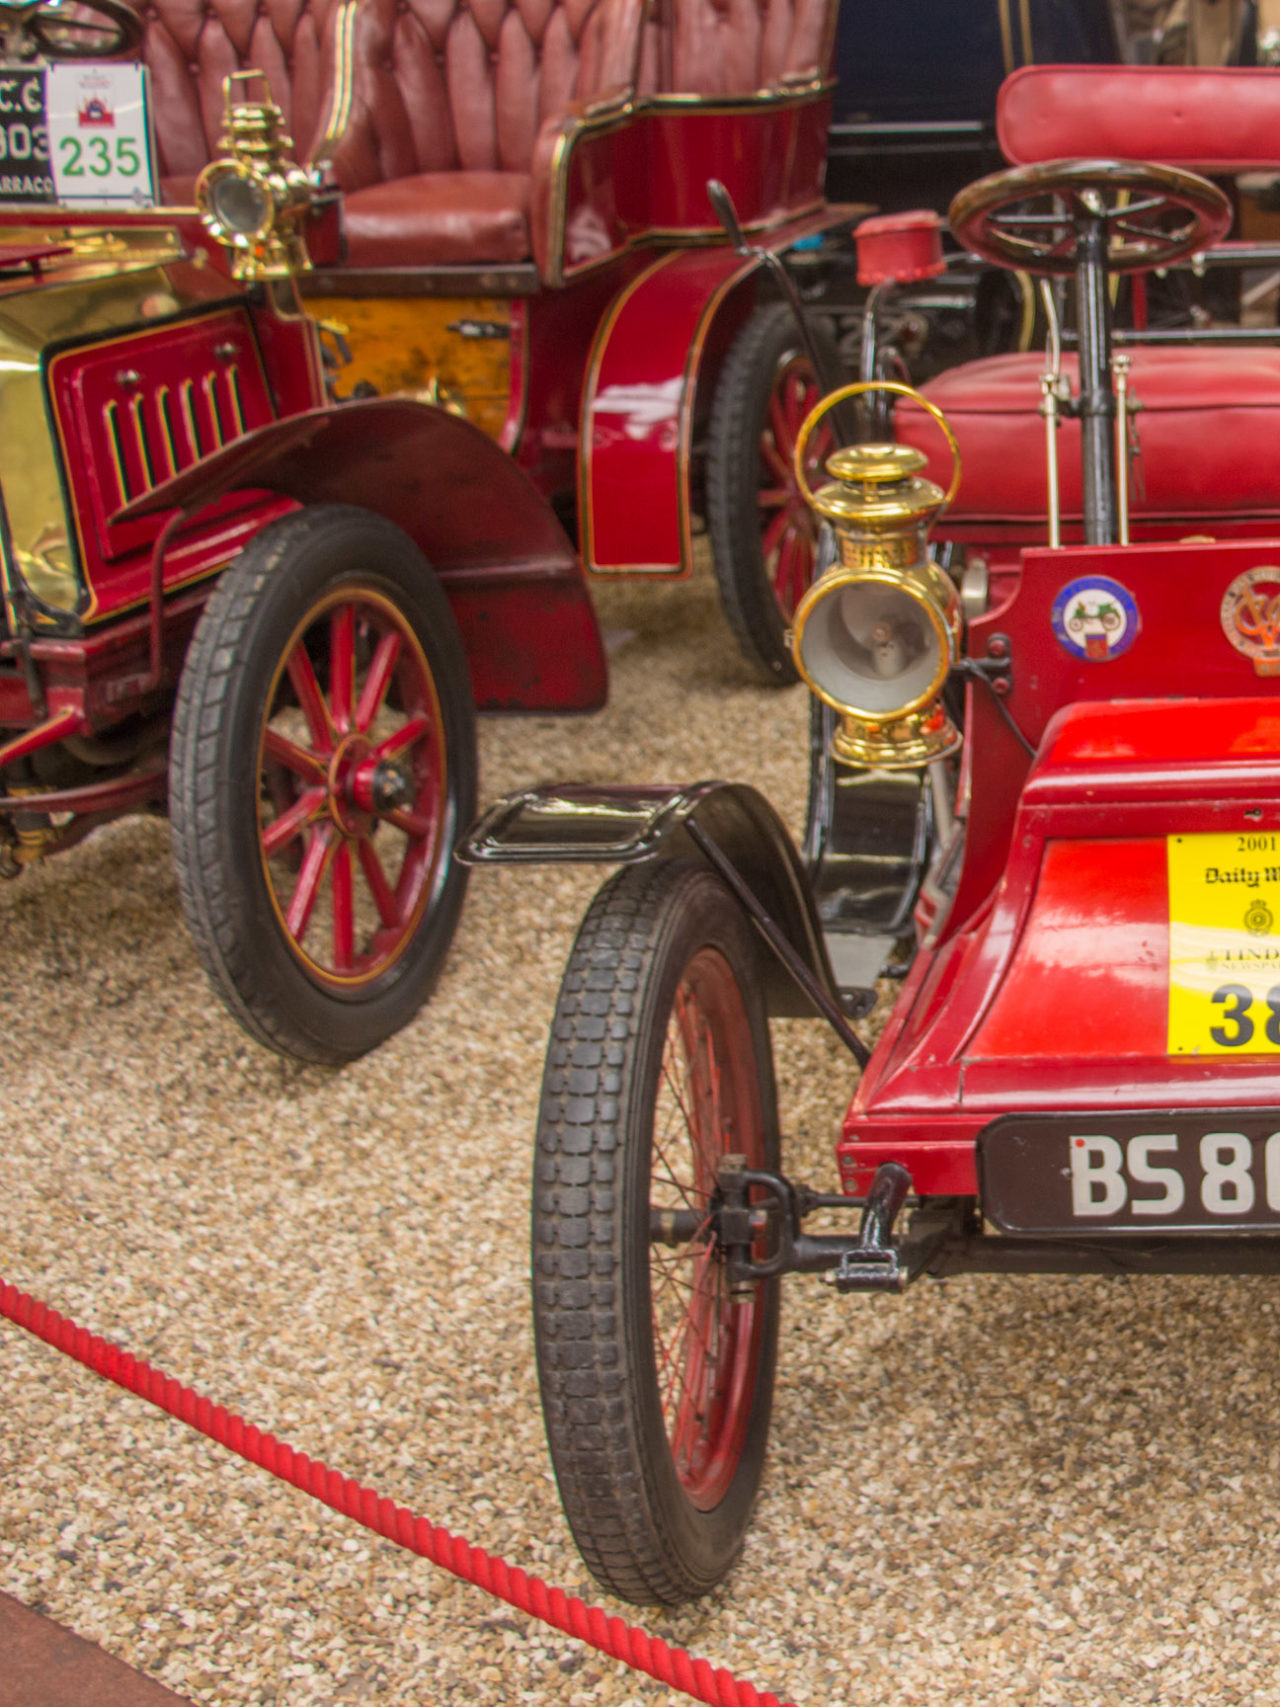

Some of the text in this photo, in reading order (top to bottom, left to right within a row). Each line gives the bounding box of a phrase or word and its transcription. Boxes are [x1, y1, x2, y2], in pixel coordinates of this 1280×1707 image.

[58, 136, 140, 177] 235
[1236, 836, 1277, 852] 2001
[1205, 867, 1260, 888] Daily
[1069, 1133, 1185, 1217] BS
